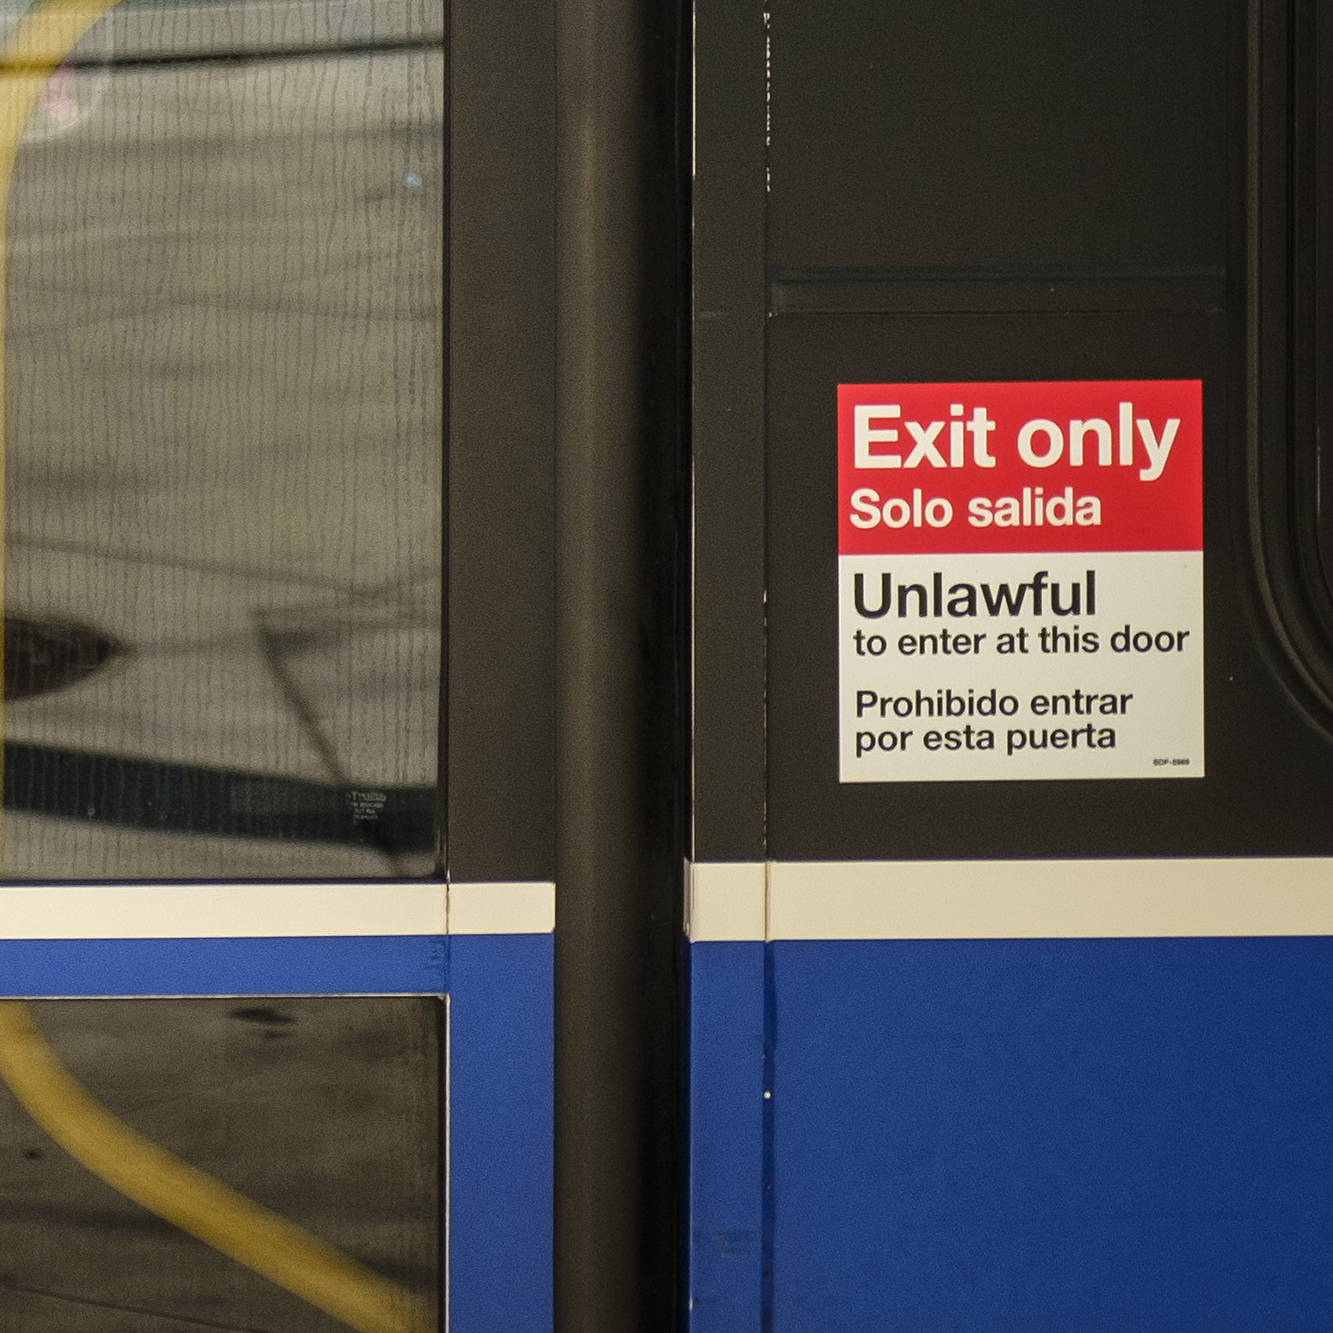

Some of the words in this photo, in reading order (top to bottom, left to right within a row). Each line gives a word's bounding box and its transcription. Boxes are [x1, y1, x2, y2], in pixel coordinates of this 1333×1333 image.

[854, 404, 995, 468] Exit
[1018, 402, 1180, 481] only
[850, 488, 952, 528] Solo
[968, 487, 1101, 527] salida
[854, 570, 1095, 619] Unlawful
[853, 630, 886, 656] to
[898, 629, 986, 655] enter
[997, 628, 1028, 654] at
[1038, 625, 1099, 653] this
[1111, 625, 1189, 652] door
[857, 689, 1018, 717] Prohibido
[1031, 690, 1133, 715] entrar
[856, 731, 913, 758] por
[924, 725, 994, 750] esta
[1007, 723, 1115, 755] puerta
